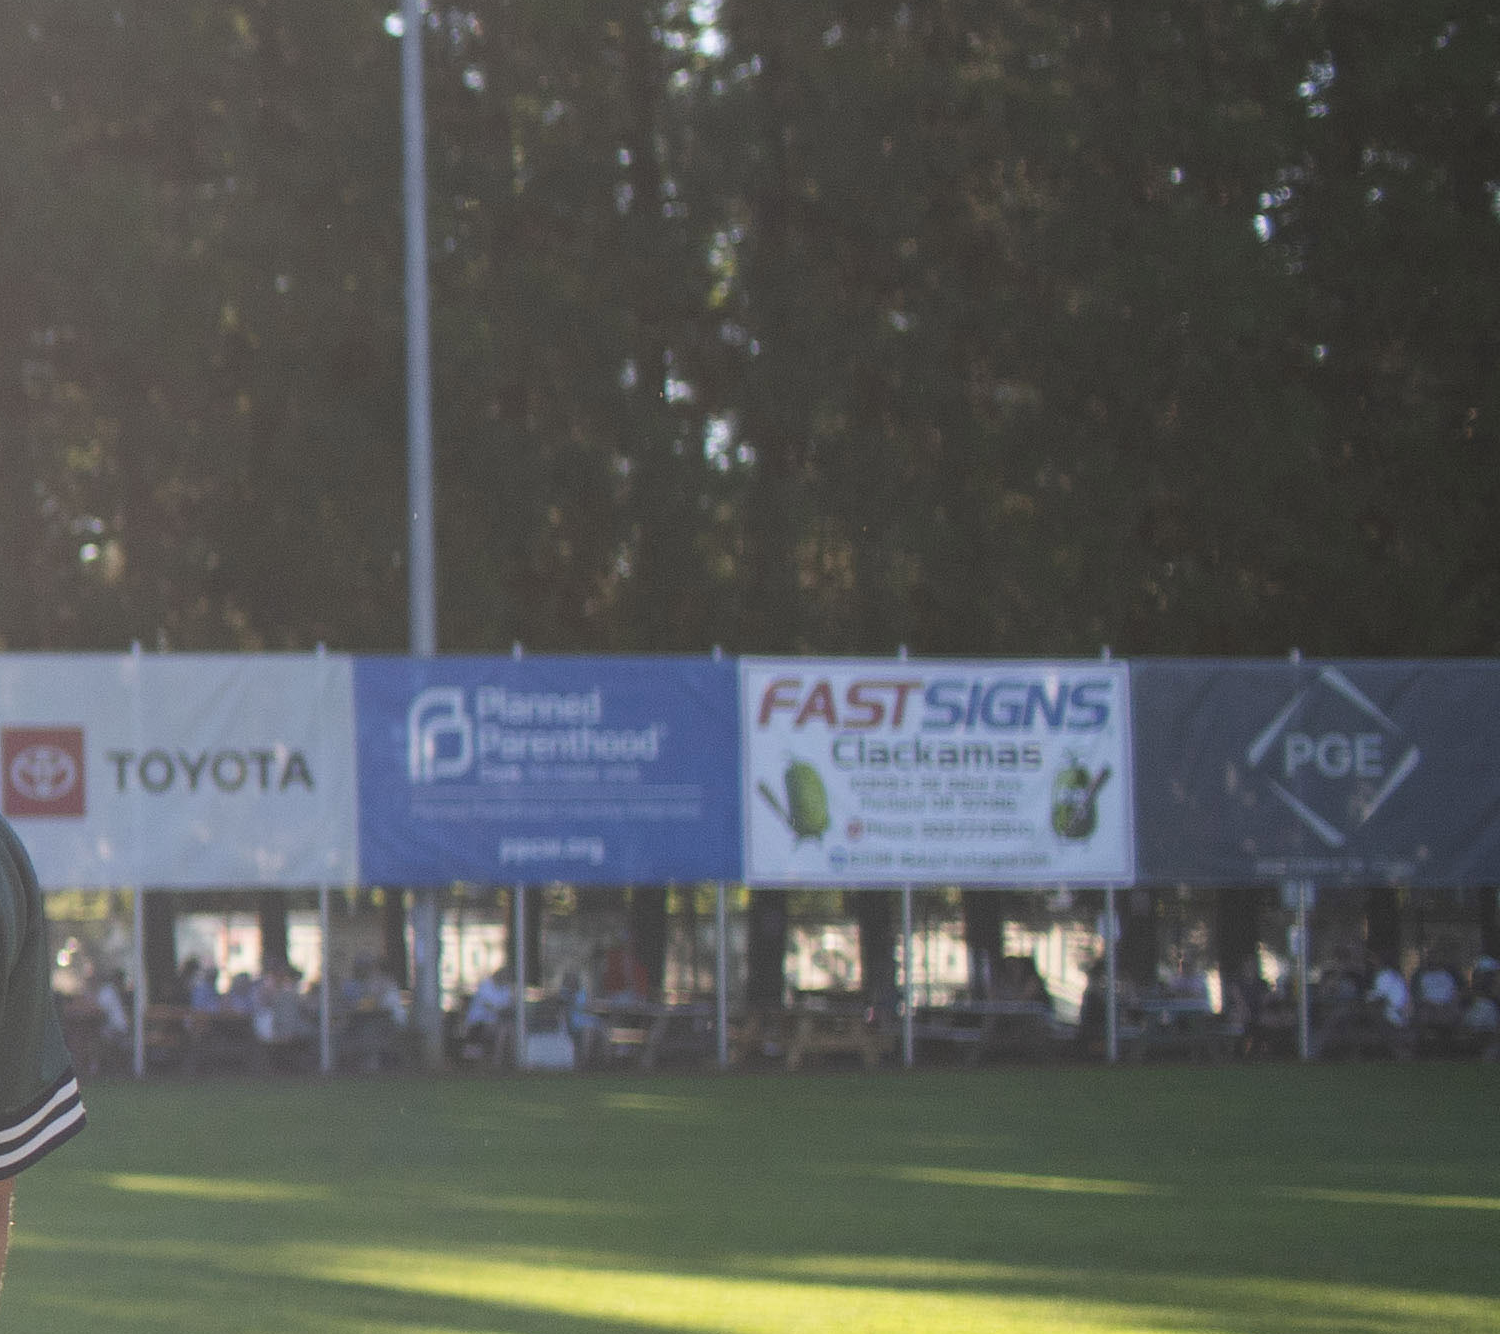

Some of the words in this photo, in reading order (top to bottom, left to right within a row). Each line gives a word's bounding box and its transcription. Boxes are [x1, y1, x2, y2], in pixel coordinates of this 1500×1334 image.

[477, 685, 601, 724] Planned
[755, 678, 1114, 731] FASTSIGNS
[105, 746, 315, 793] TOYOTA
[831, 735, 1043, 767] Clackamas
[1284, 731, 1384, 779] PGE
